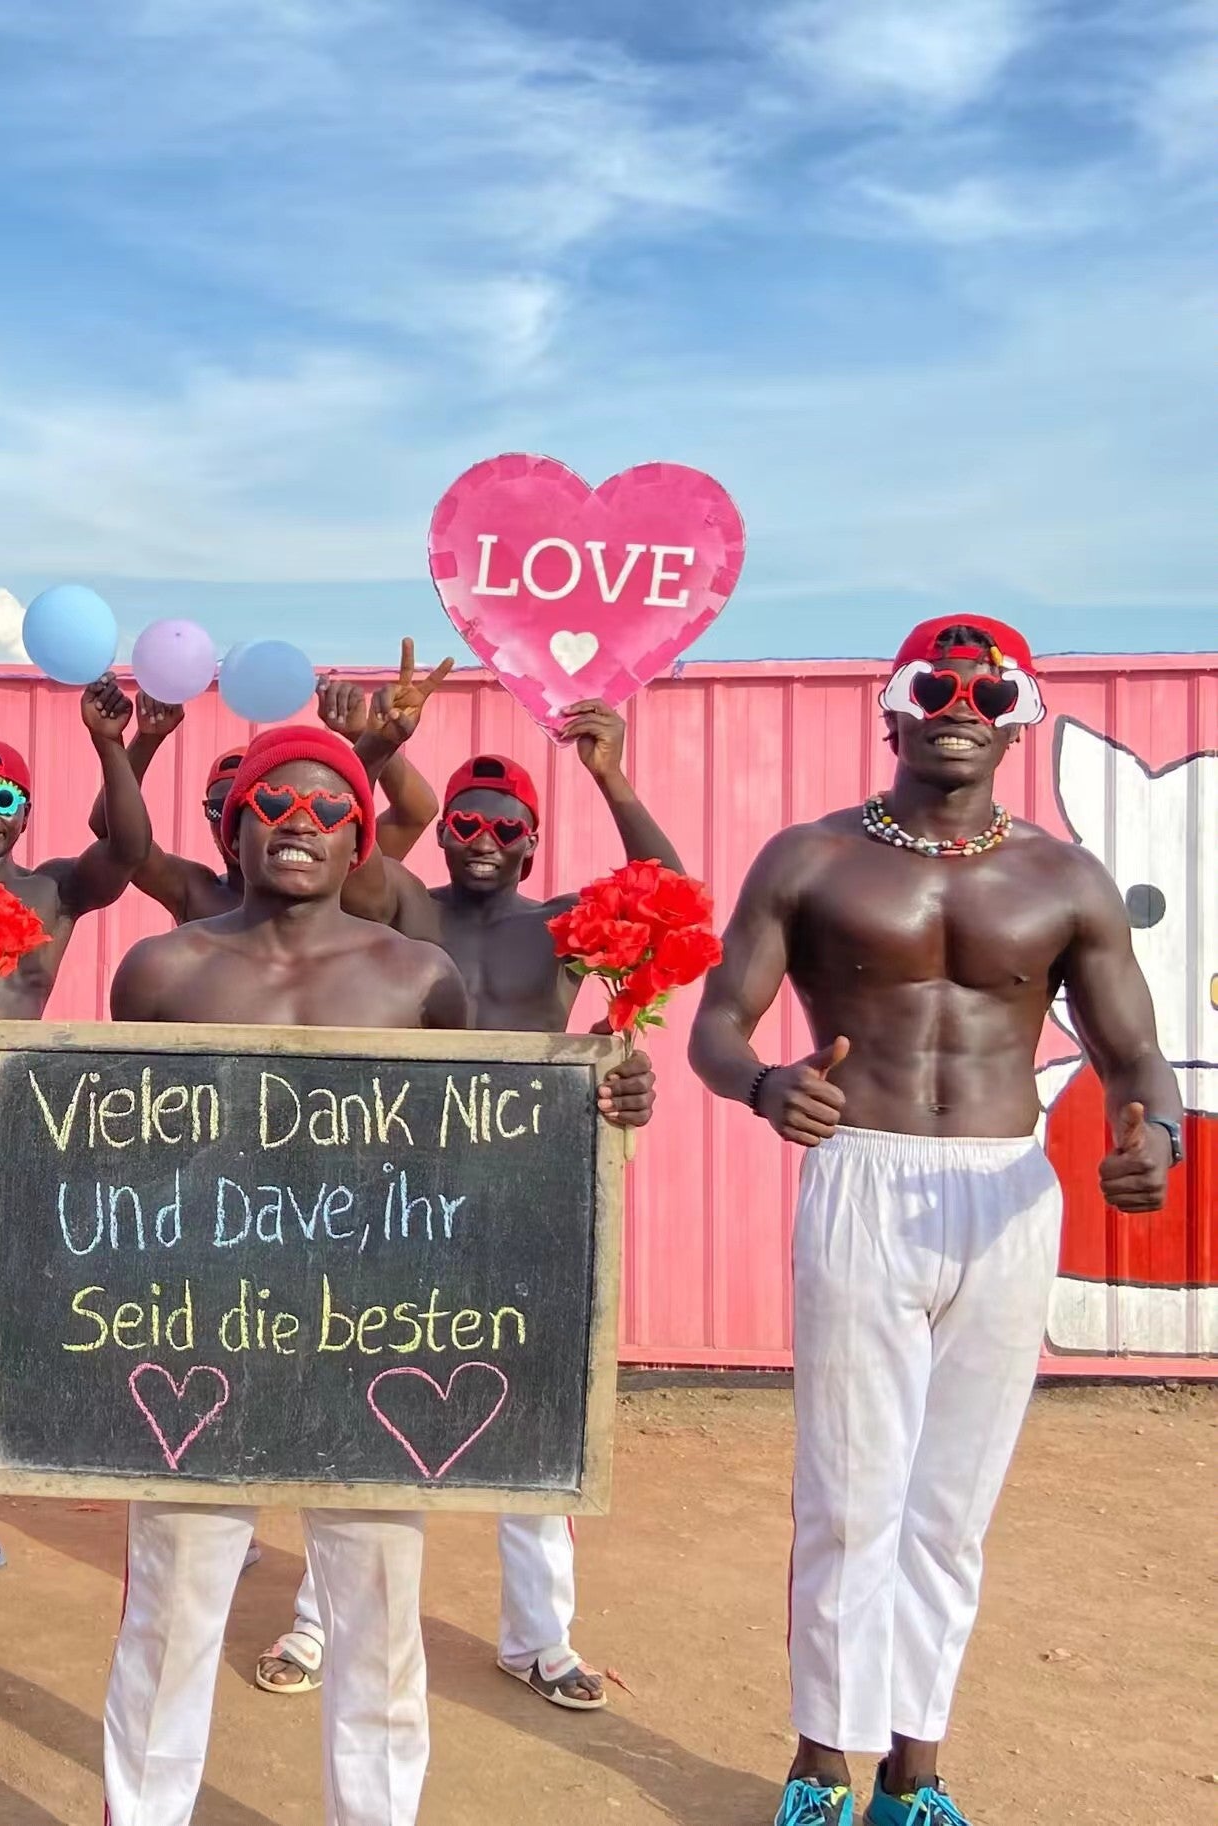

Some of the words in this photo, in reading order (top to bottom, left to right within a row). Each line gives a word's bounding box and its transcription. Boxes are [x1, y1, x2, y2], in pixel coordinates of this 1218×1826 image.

[471, 534, 695, 608] LOVE
[28, 1067, 220, 1152] Vielen
[439, 1073, 543, 1148] Nici
[58, 1168, 181, 1256] Und
[212, 1176, 370, 1254] Dave,
[382, 1162, 467, 1242] ihr
[61, 1279, 194, 1352] Seid
[218, 1278, 300, 1355] die
[317, 1274, 527, 1353] besten
